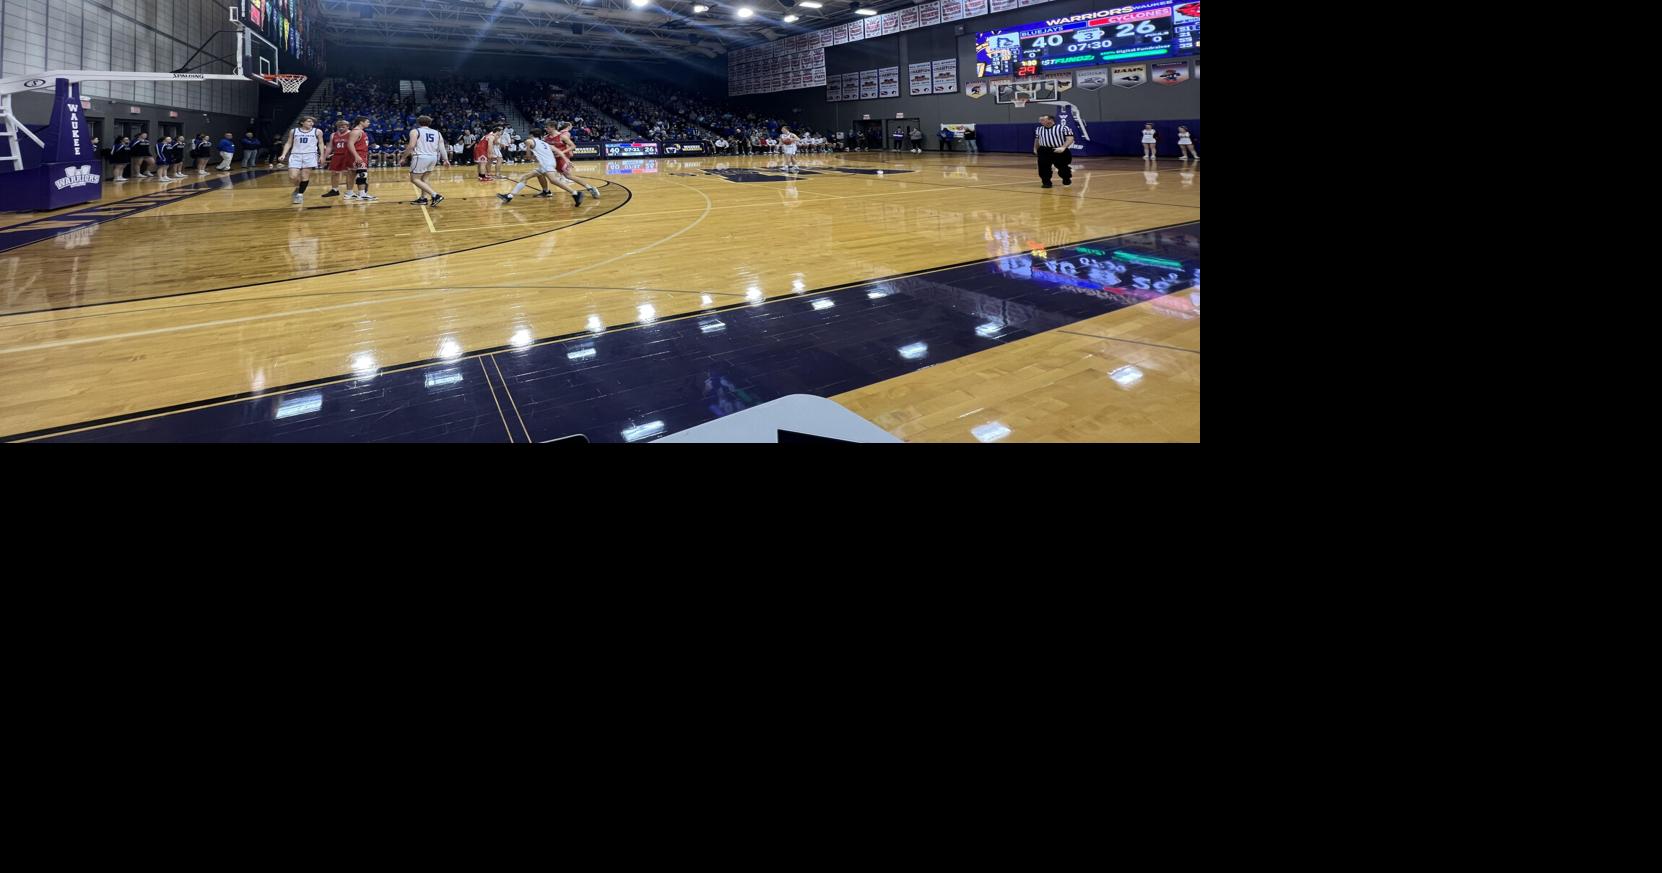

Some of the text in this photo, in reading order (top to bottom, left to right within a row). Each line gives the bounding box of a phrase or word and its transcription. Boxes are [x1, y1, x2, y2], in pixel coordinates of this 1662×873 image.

[1046, 6, 1134, 26] WARRIORS
[1108, 7, 1169, 22] CYCLONES
[1021, 26, 1064, 37] BLUEJAYS
[1116, 20, 1156, 37] 26
[1032, 34, 1063, 48] 40
[1067, 40, 1112, 52] 07:30
[1018, 66, 1036, 76] 29
[67, 103, 81, 155] WAUKEE
[425, 132, 435, 142] 15
[55, 173, 100, 190] WARRIORS
